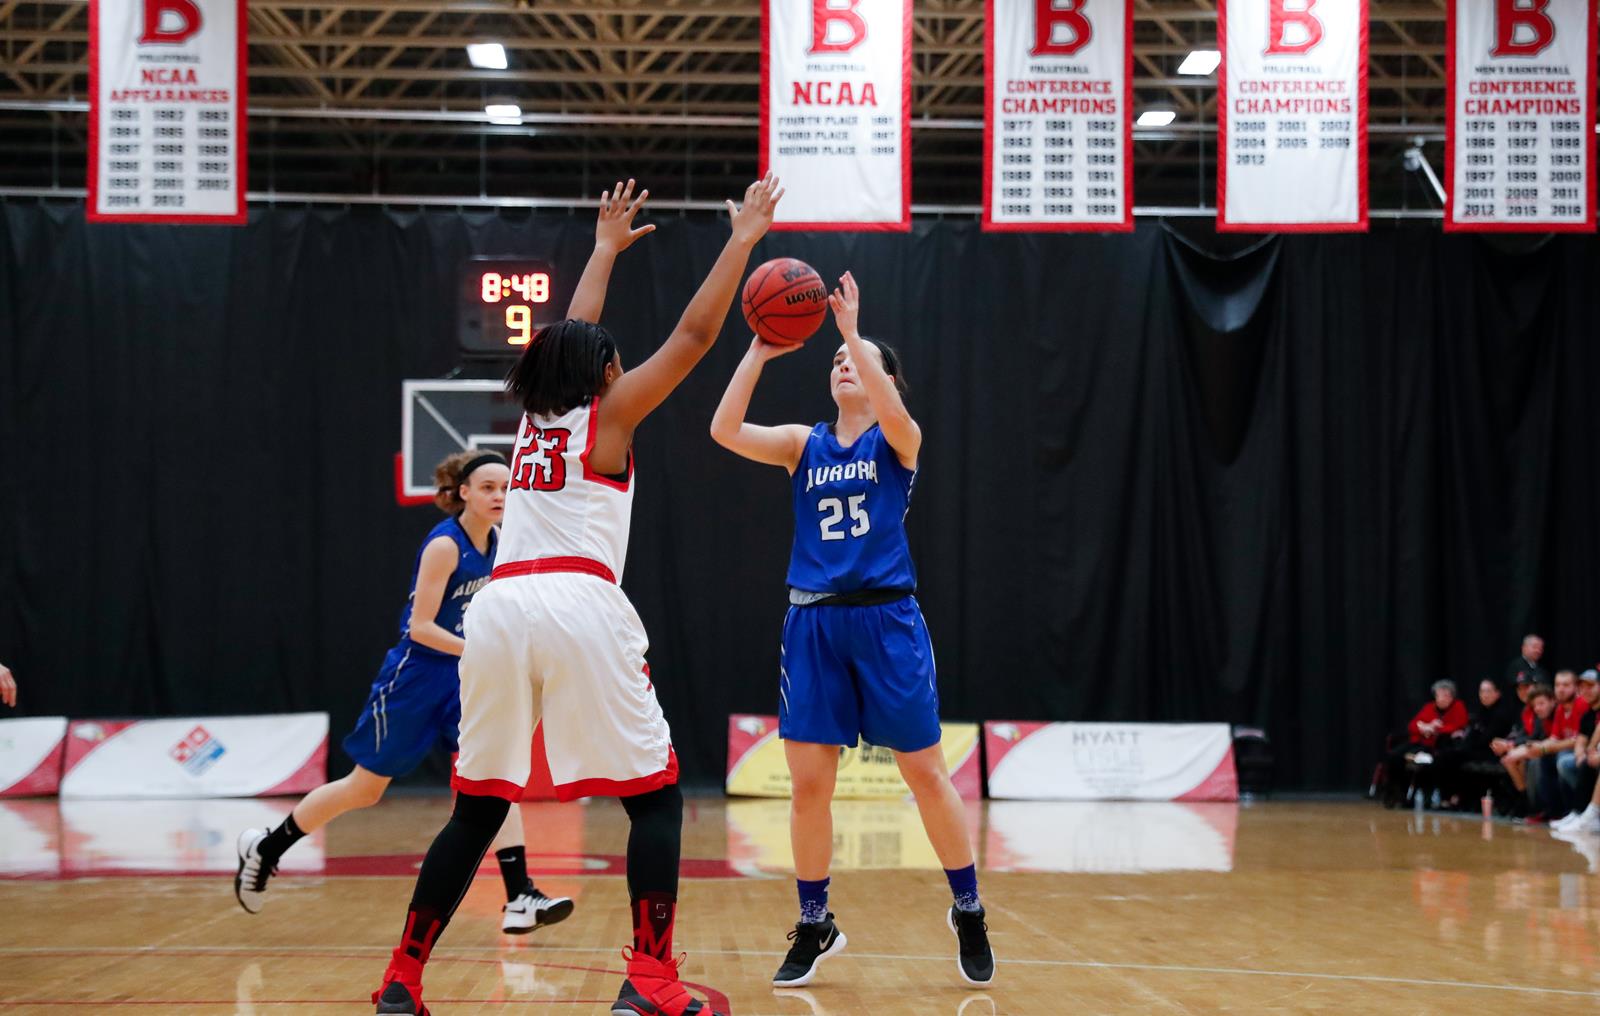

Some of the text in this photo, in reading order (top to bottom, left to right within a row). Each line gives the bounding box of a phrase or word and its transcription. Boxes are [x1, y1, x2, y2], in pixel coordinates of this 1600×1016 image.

[805, 0, 868, 55] B
[1028, 0, 1093, 57] B
[1262, 0, 1324, 57] B
[1488, 0, 1556, 60] B
[141, 69, 197, 84] NCAA
[792, 82, 878, 106] NCAA
[1007, 80, 1112, 94] CONFERENCE
[1239, 80, 1347, 94] CONFERENCE
[1469, 81, 1577, 95] CONFERENCE
[110, 90, 230, 102] APPEARANCES
[1002, 98, 1117, 114] CHAMPIONS
[1234, 98, 1351, 114] CHAMPIONS
[1464, 99, 1581, 115] CHAMPIONS
[1003, 120, 1032, 132] 1977
[1235, 121, 1265, 132] 2000
[1277, 121, 1306, 132] 2001
[1465, 121, 1495, 133] 1976
[1507, 121, 1537, 133] 1979
[1235, 138, 1265, 149] 2004
[1507, 138, 1537, 149] 1987
[1235, 154, 1265, 166] 2012
[1465, 154, 1580, 166] 1991 1992 1993
[1465, 171, 1580, 183] 1997 1999 2000
[1465, 188, 1580, 200] 2001 2009 2011
[1465, 205, 1580, 216] 2012 2015 2016
[481, 272, 549, 303] 8:48
[505, 305, 531, 345] 9
[510, 422, 572, 491] 23
[805, 460, 878, 493] AURORA
[818, 492, 871, 541] 25
[451, 574, 491, 600] AUR
[1072, 730, 1141, 746] HYATT
